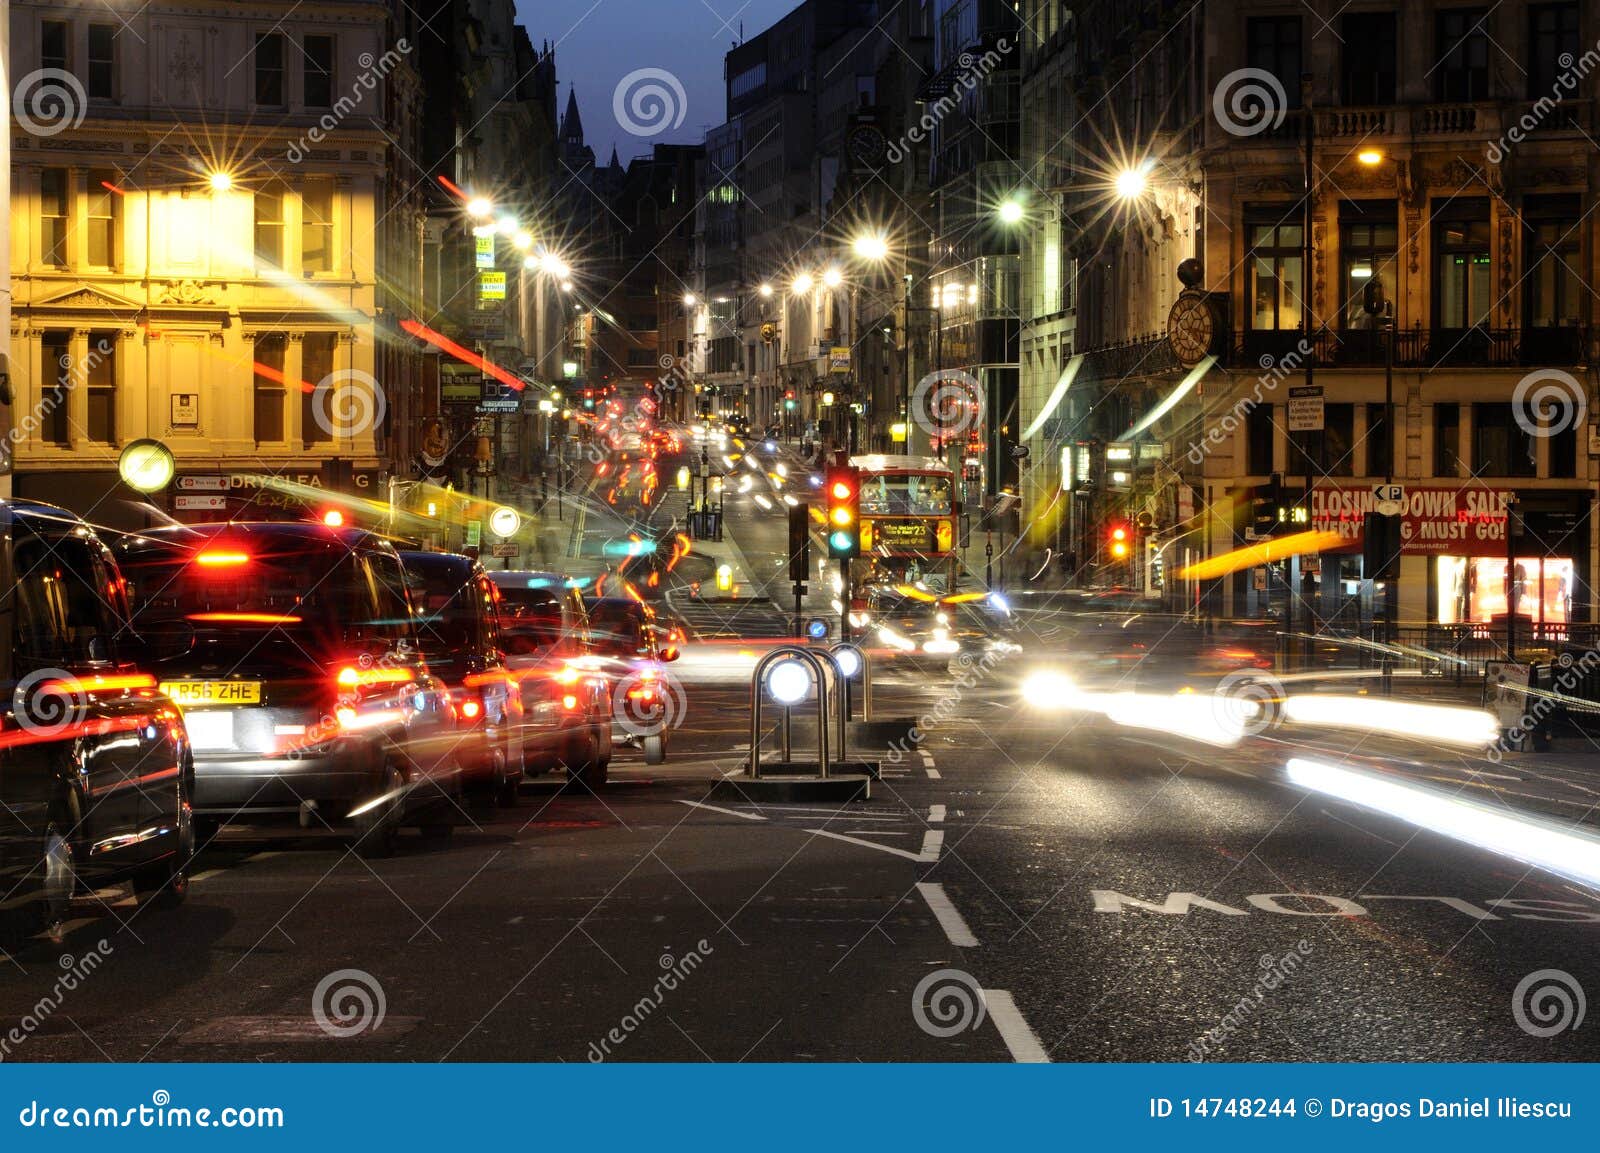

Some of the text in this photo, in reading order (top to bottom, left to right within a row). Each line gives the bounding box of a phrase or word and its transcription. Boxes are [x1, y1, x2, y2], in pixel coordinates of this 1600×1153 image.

[1391, 487, 1401, 499] P
[1311, 490, 1381, 518] CLOSIN
[1465, 490, 1508, 518] SALE
[915, 526, 926, 535] 23
[1420, 520, 1468, 540] MUST
[1475, 520, 1506, 540] GO!
[218, 683, 253, 699] ZHE
